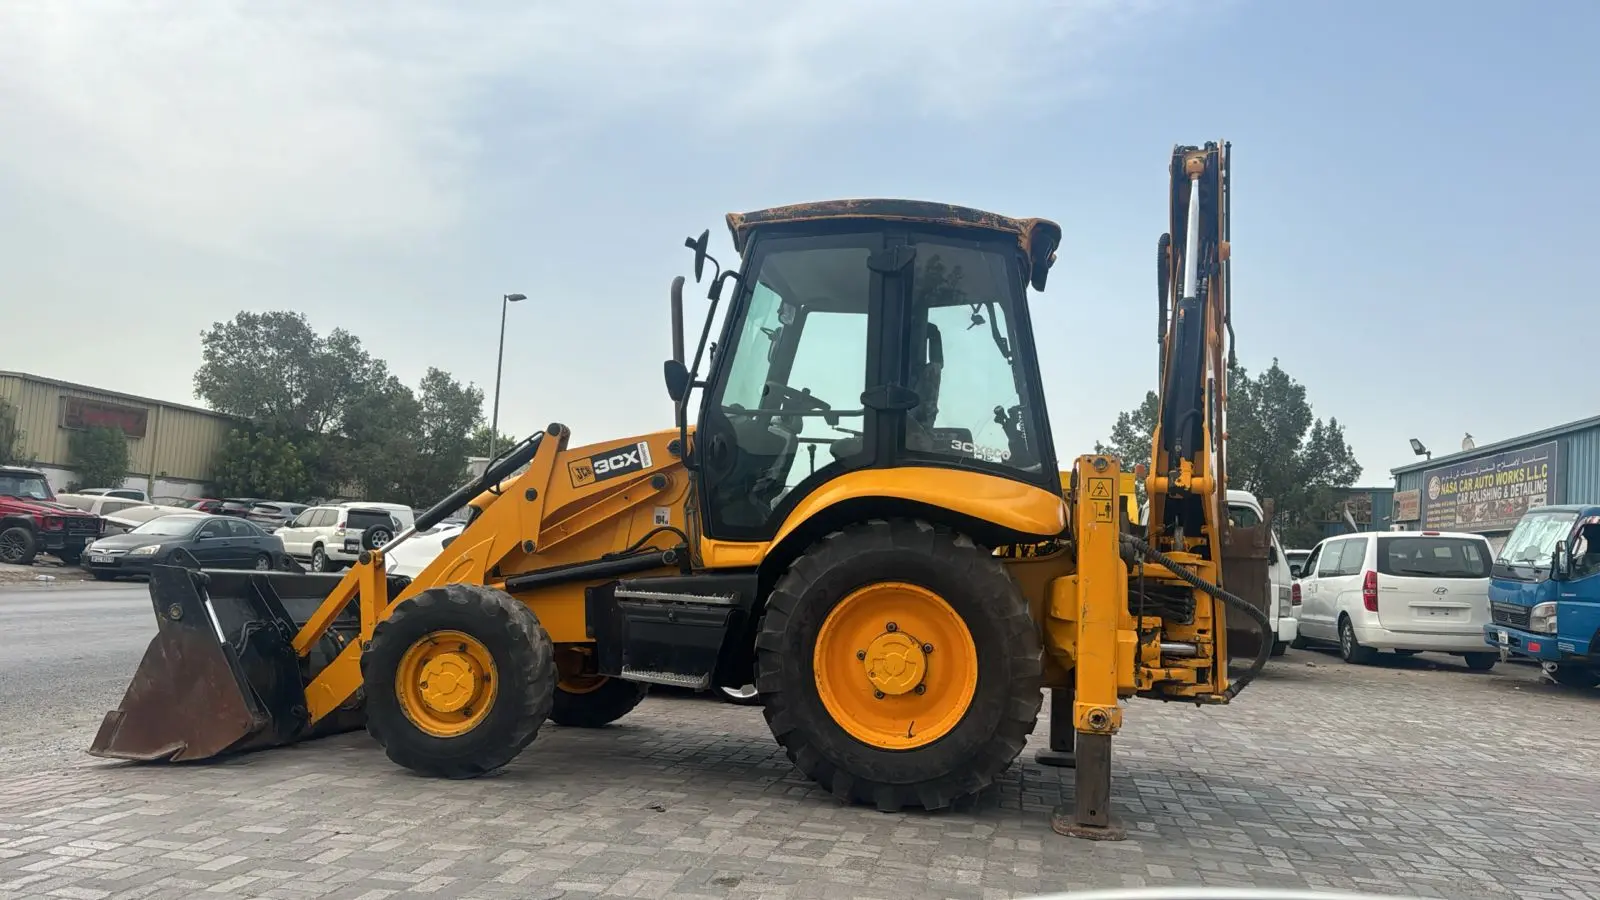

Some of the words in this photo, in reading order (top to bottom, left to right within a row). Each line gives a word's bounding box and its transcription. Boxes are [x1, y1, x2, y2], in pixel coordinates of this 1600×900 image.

[593, 449, 640, 475] 3CX
[1440, 482, 1458, 496] NASA
[1459, 479, 1473, 492] CAR
[1474, 474, 1494, 489] AUTO
[1495, 468, 1525, 486] WORKS
[1527, 463, 1548, 480] L.L.C
[1456, 492, 1469, 504] CAR
[1469, 487, 1502, 503] POLISHING
[1503, 486, 1509, 498] &
[1510, 479, 1548, 497] DETAILING
